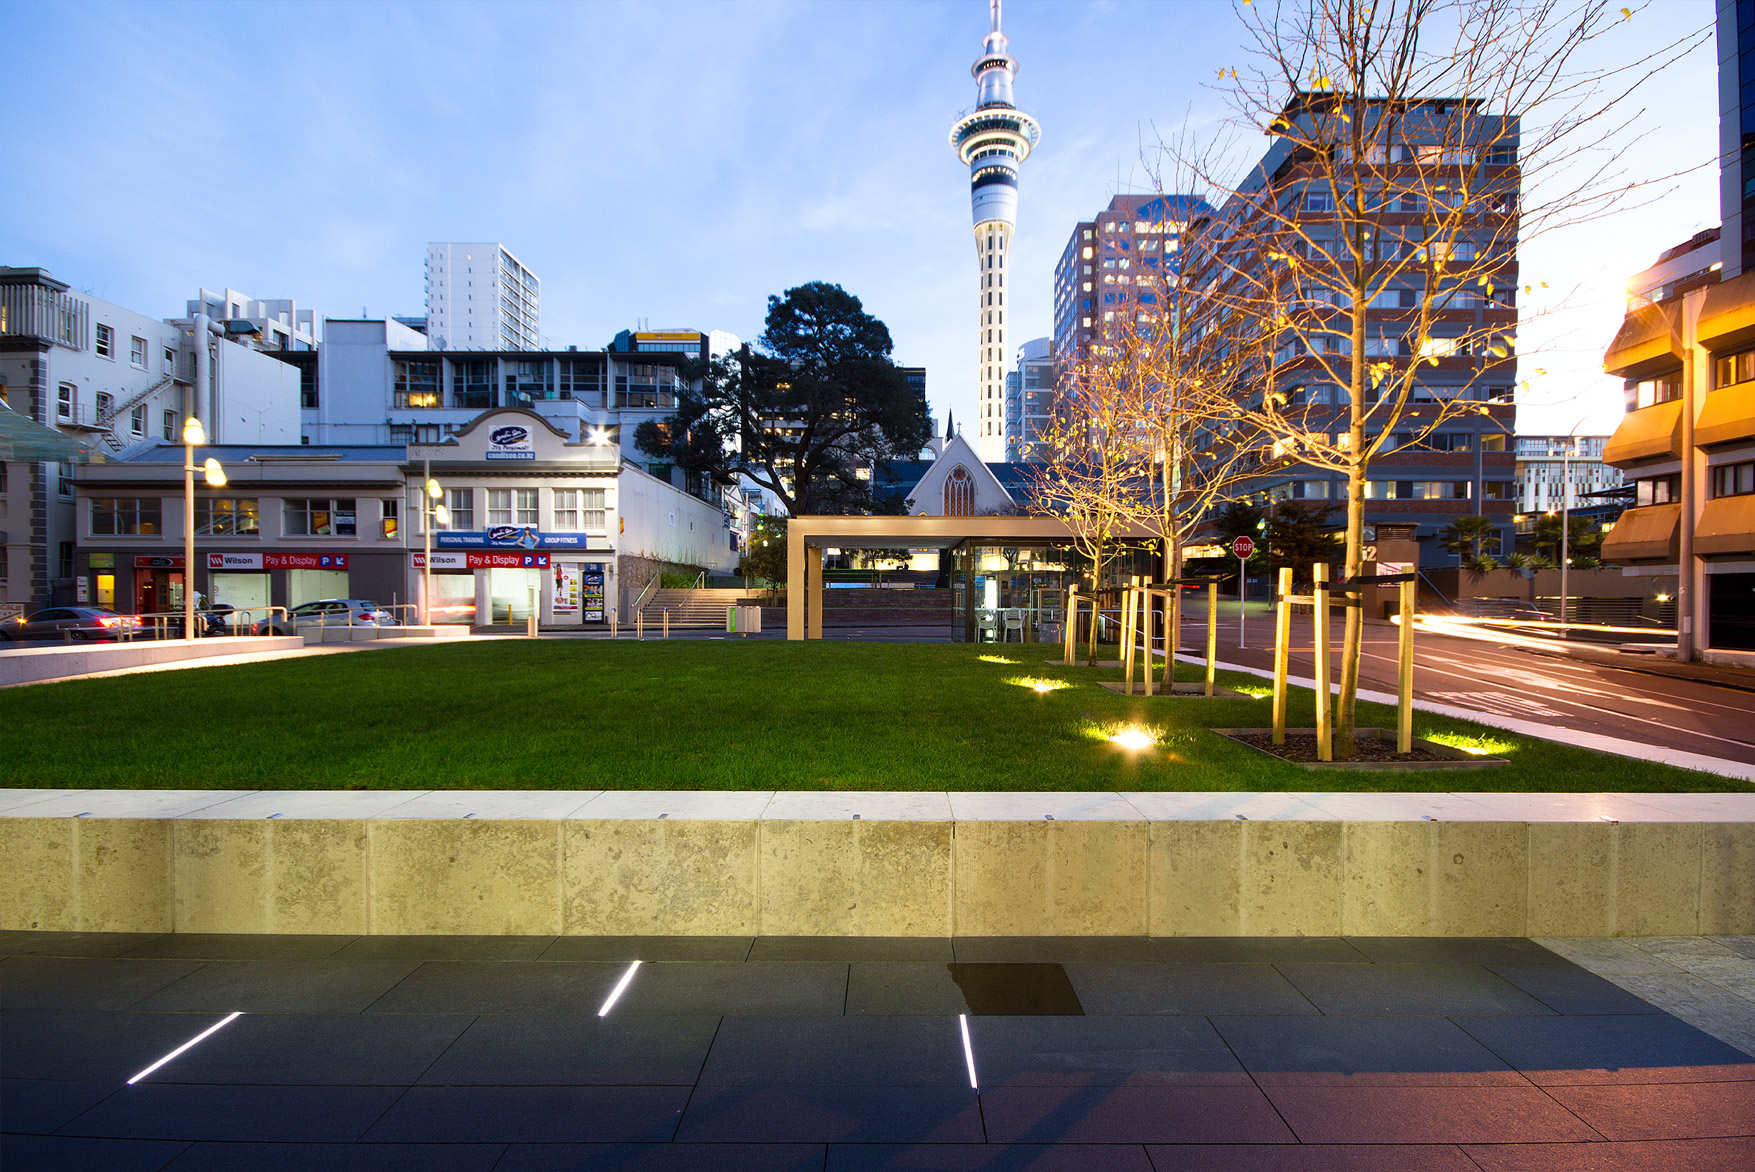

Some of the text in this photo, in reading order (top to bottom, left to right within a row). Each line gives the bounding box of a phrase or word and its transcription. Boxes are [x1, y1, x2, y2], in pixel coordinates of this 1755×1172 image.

[1235, 543, 1253, 552] STOP
[265, 556, 280, 566] Pay
[281, 556, 288, 565] &
[289, 556, 317, 566] Display
[469, 555, 483, 566] Pay
[484, 555, 491, 564] &
[492, 555, 519, 566] Display
